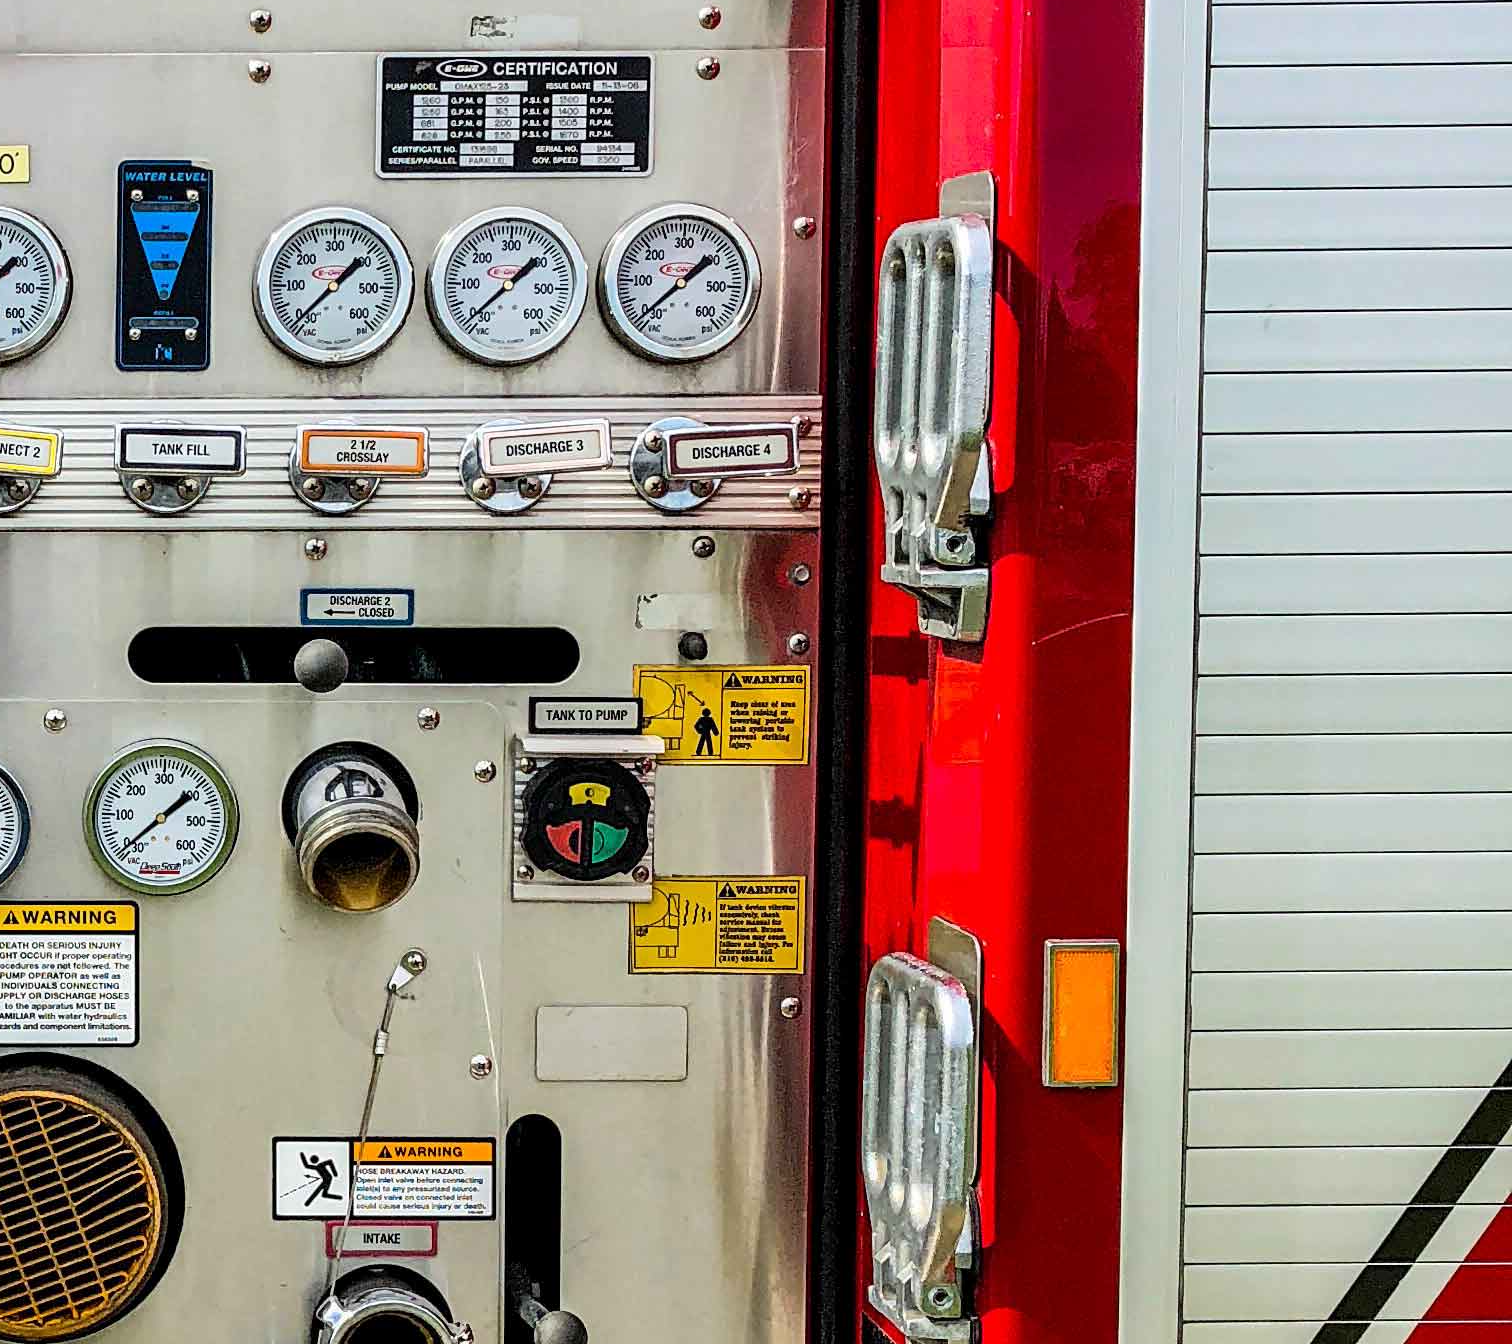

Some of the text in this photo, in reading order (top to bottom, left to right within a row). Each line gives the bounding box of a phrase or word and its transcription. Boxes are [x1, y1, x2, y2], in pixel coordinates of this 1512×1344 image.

[493, 62, 618, 76] CERTIFICATION
[385, 83, 438, 91] PUMP MODEL
[568, 82, 591, 90] DATE
[125, 172, 207, 182] WATER LEVEL
[325, 239, 345, 252] 300
[500, 239, 522, 252] 300
[673, 236, 694, 250] 300
[32, 444, 41, 458] 2
[151, 442, 210, 458] TANK FILL
[351, 439, 376, 451] 2 1/2
[505, 439, 584, 458] DISCHARGE 3
[692, 443, 771, 459] DISCHARGE 4
[336, 451, 390, 464] CROSSLAY
[329, 595, 390, 607] DISCHARGE 2
[358, 606, 394, 618] CLOSED
[741, 674, 803, 685] WARNING
[546, 709, 628, 721] TANK TO PUMP
[154, 773, 174, 785] 300
[175, 839, 196, 851] 600
[735, 885, 797, 894] WARNING
[22, 911, 117, 925] WARNING
[62, 953, 90, 961] proper
[92, 952, 132, 961] operating
[1, 982, 120, 990] INDIVIDUALS CONNECTING
[44, 992, 97, 1000] DISCHARGE
[99, 992, 130, 1000] HOSES
[394, 1147, 463, 1157] WARNING
[363, 1233, 401, 1244] INTAKE
